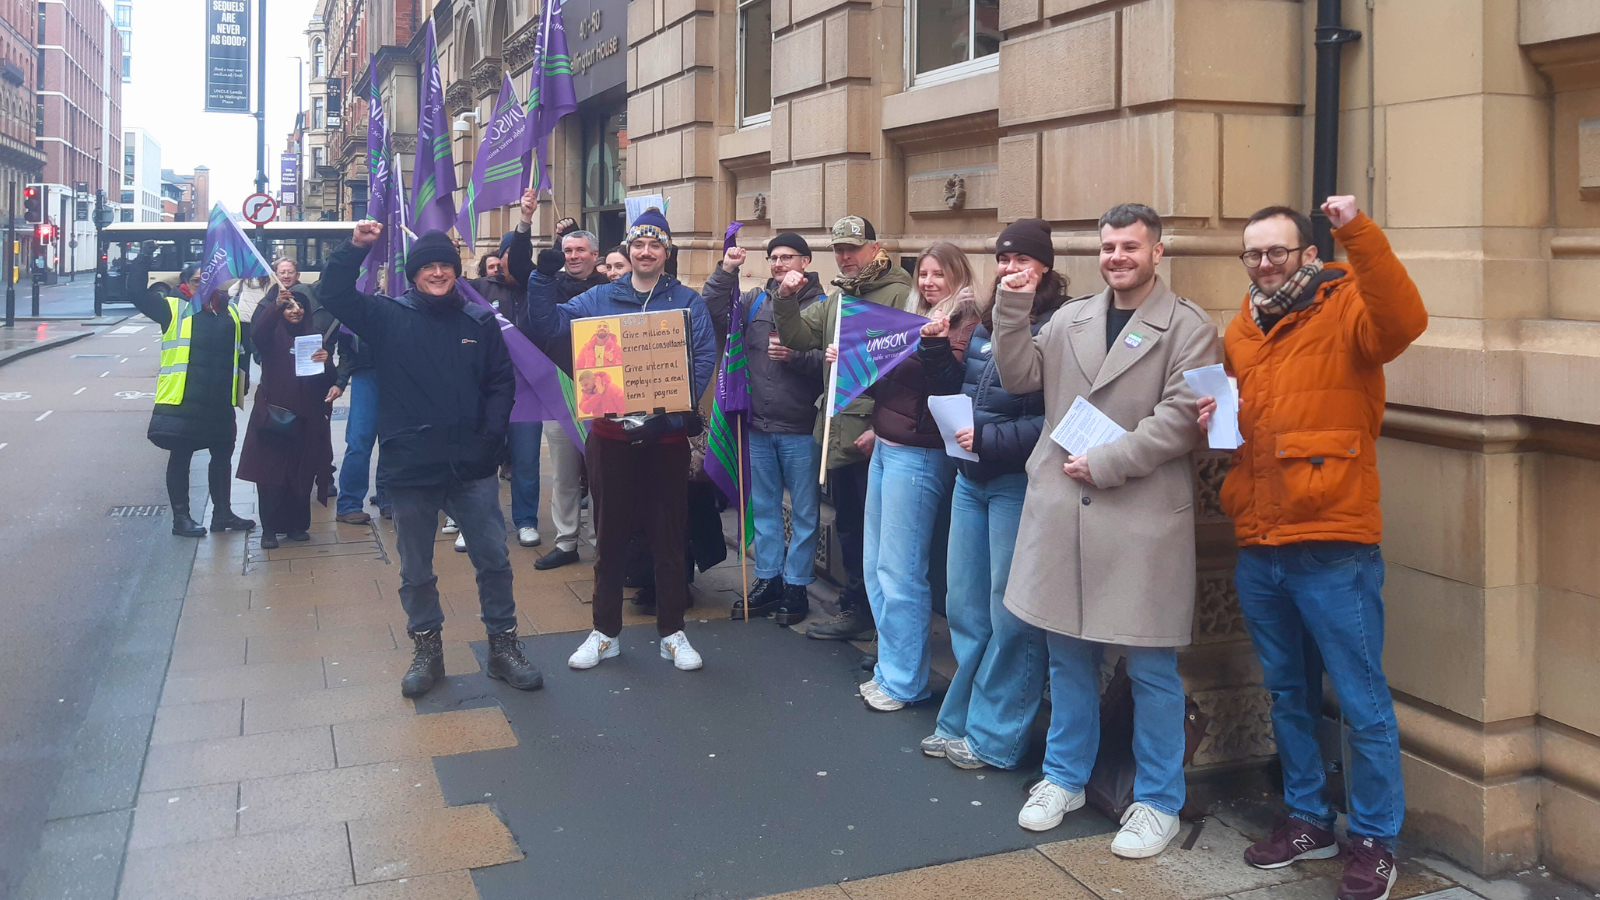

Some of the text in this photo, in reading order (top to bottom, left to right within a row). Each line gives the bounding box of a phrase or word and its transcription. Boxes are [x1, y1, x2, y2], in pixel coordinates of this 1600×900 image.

[213, 1, 244, 12] SEQUELS
[221, 13, 236, 23] ARE
[216, 23, 241, 35] NEVER
[210, 34, 247, 47] AS GOOD?
[569, 47, 596, 76] ellington
[595, 35, 618, 62] House
[622, 327, 680, 339] Give millions to
[622, 339, 687, 353] external consultants
[866, 331, 908, 353] UNISON
[624, 359, 679, 373] Give internal
[625, 375, 662, 388] employees
[670, 373, 685, 382] real
[626, 391, 646, 400] terms
